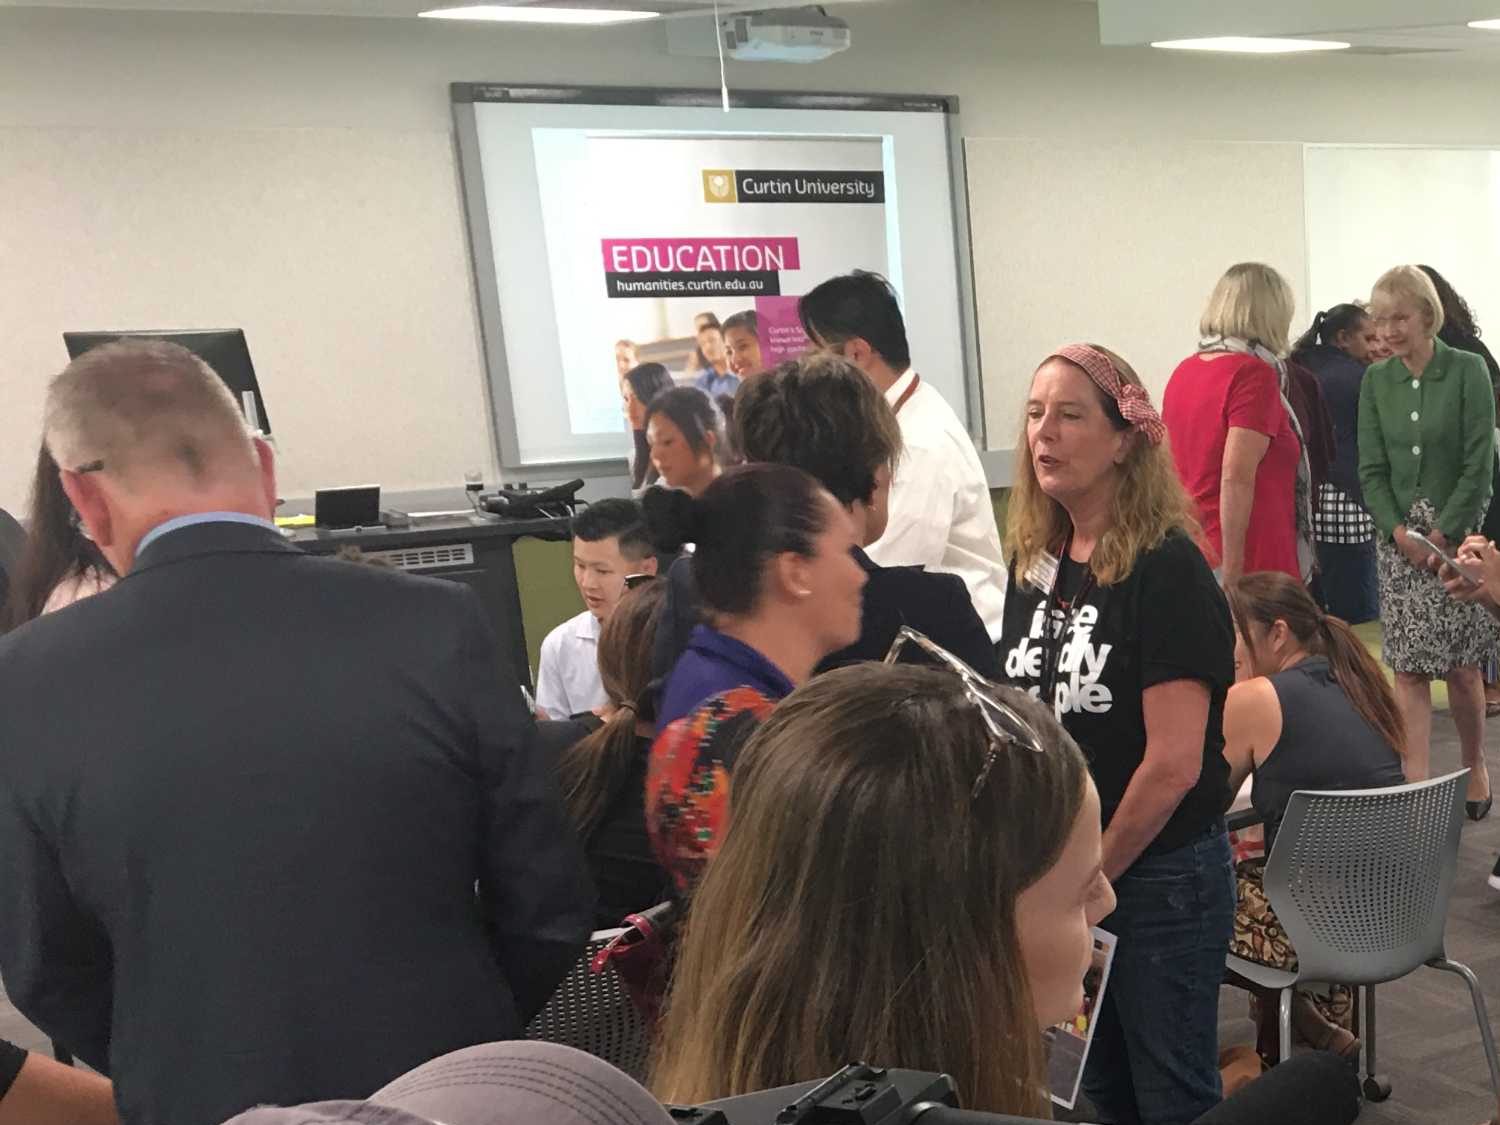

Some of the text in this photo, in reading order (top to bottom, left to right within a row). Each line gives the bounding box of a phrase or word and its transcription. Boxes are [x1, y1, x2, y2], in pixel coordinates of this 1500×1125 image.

[742, 178, 875, 198] Curtin University
[611, 245, 785, 273] EDUCATION
[616, 279, 764, 292] humanities.curtin.edu.au
